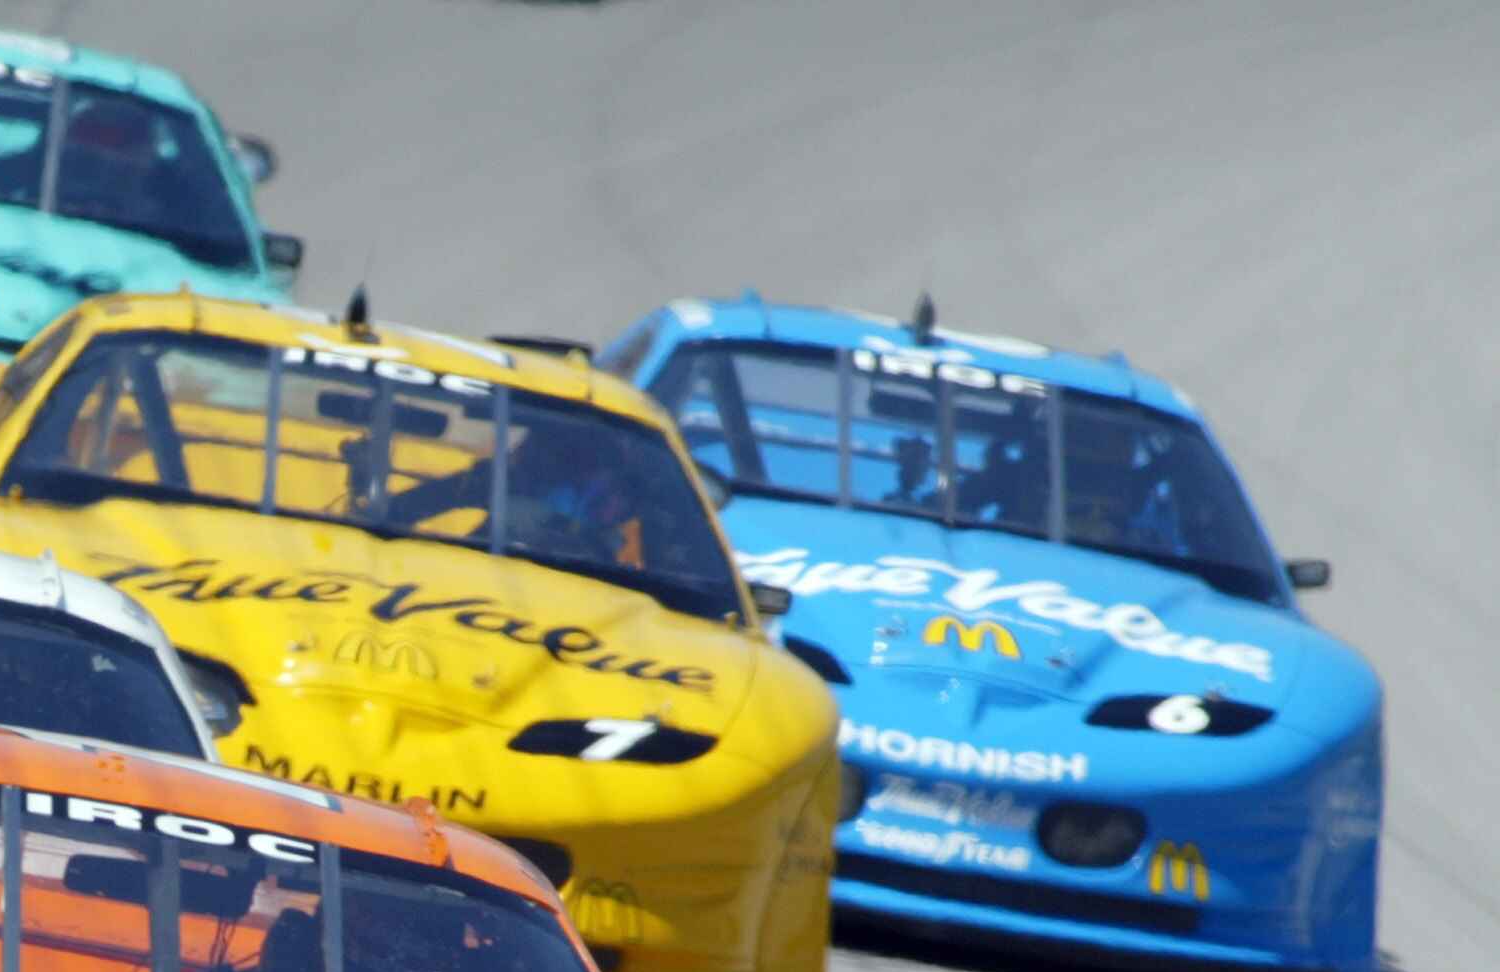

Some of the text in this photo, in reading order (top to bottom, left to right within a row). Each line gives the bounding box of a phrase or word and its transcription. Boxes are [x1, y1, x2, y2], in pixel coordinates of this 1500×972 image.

[283, 347, 493, 396] IROC
[853, 349, 1047, 398] IROC
[304, 569, 715, 690] Value
[733, 546, 931, 598] rue
[876, 556, 1275, 684] Value
[580, 720, 658, 762] 7
[1148, 694, 1211, 734] 6
[244, 744, 487, 812] MARLIN
[836, 717, 1089, 783] HORNISH
[25, 791, 316, 864] IROC
